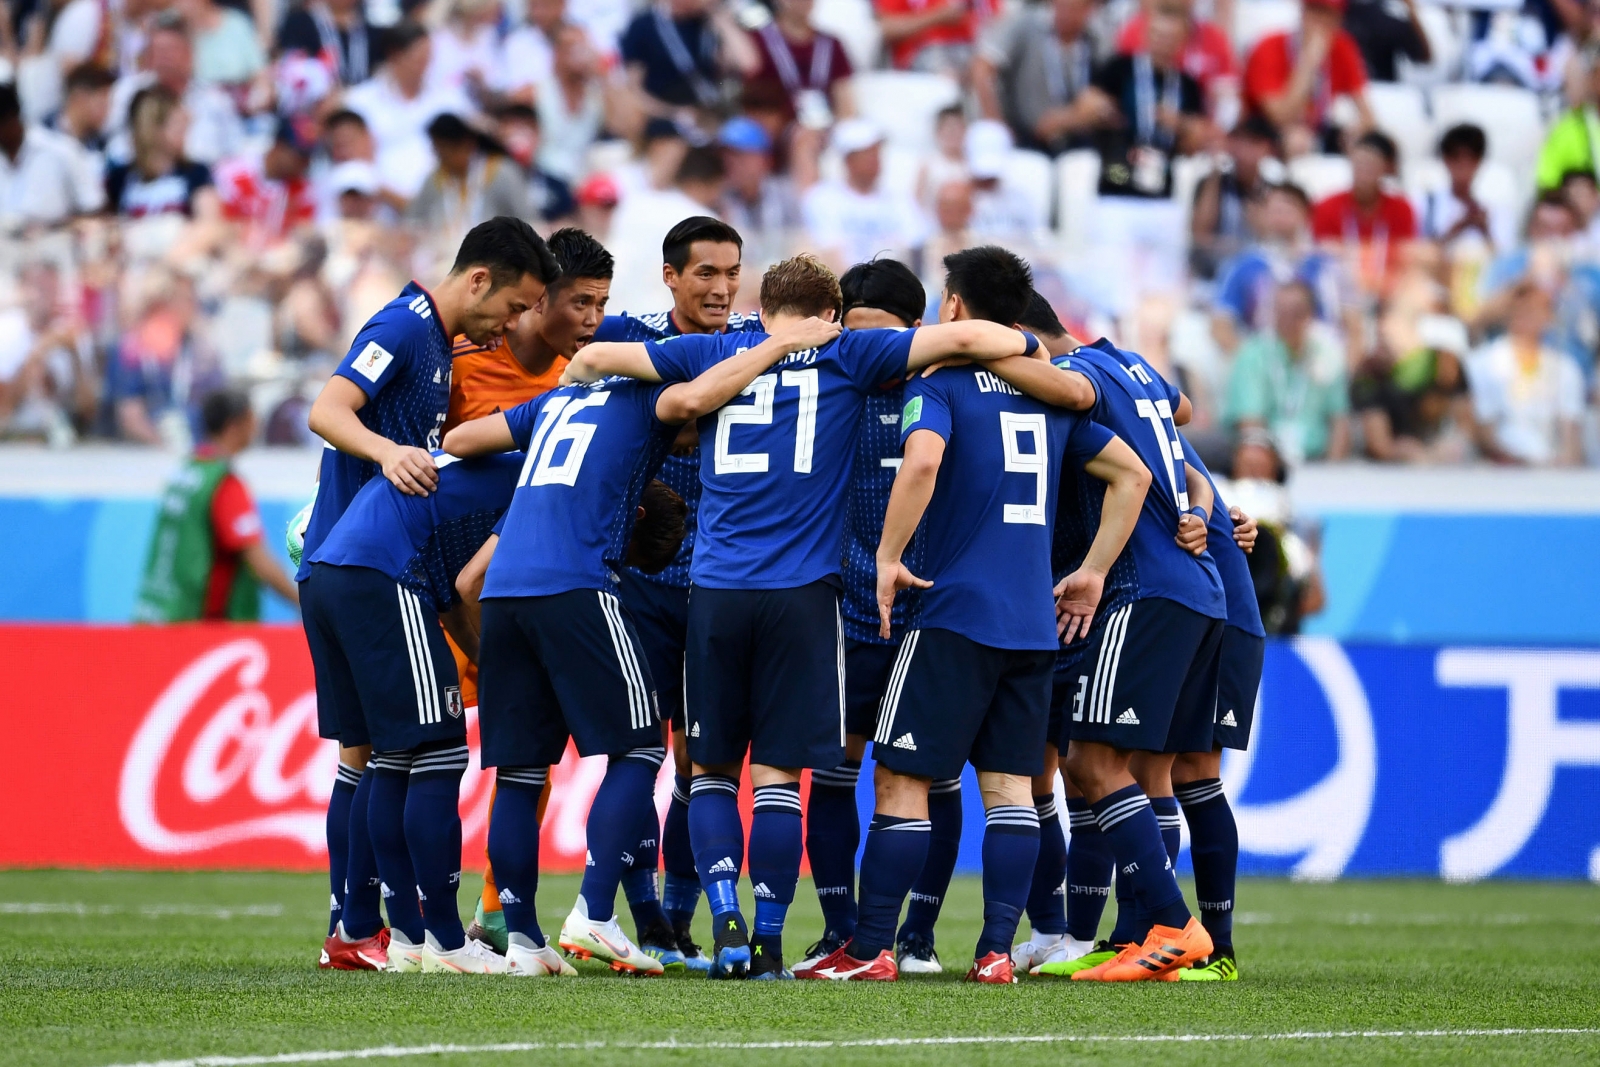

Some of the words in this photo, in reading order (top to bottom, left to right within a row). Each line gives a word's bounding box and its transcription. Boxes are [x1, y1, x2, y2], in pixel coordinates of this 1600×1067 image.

[517, 391, 611, 488] 16
[999, 411, 1048, 525] 9
[1115, 717, 1141, 725] adidas
[892, 740, 918, 751] adidas
[708, 865, 737, 874] adidas
[816, 885, 848, 896] APAN
[1070, 884, 1111, 896] JAPAN
[909, 892, 940, 905] APAN
